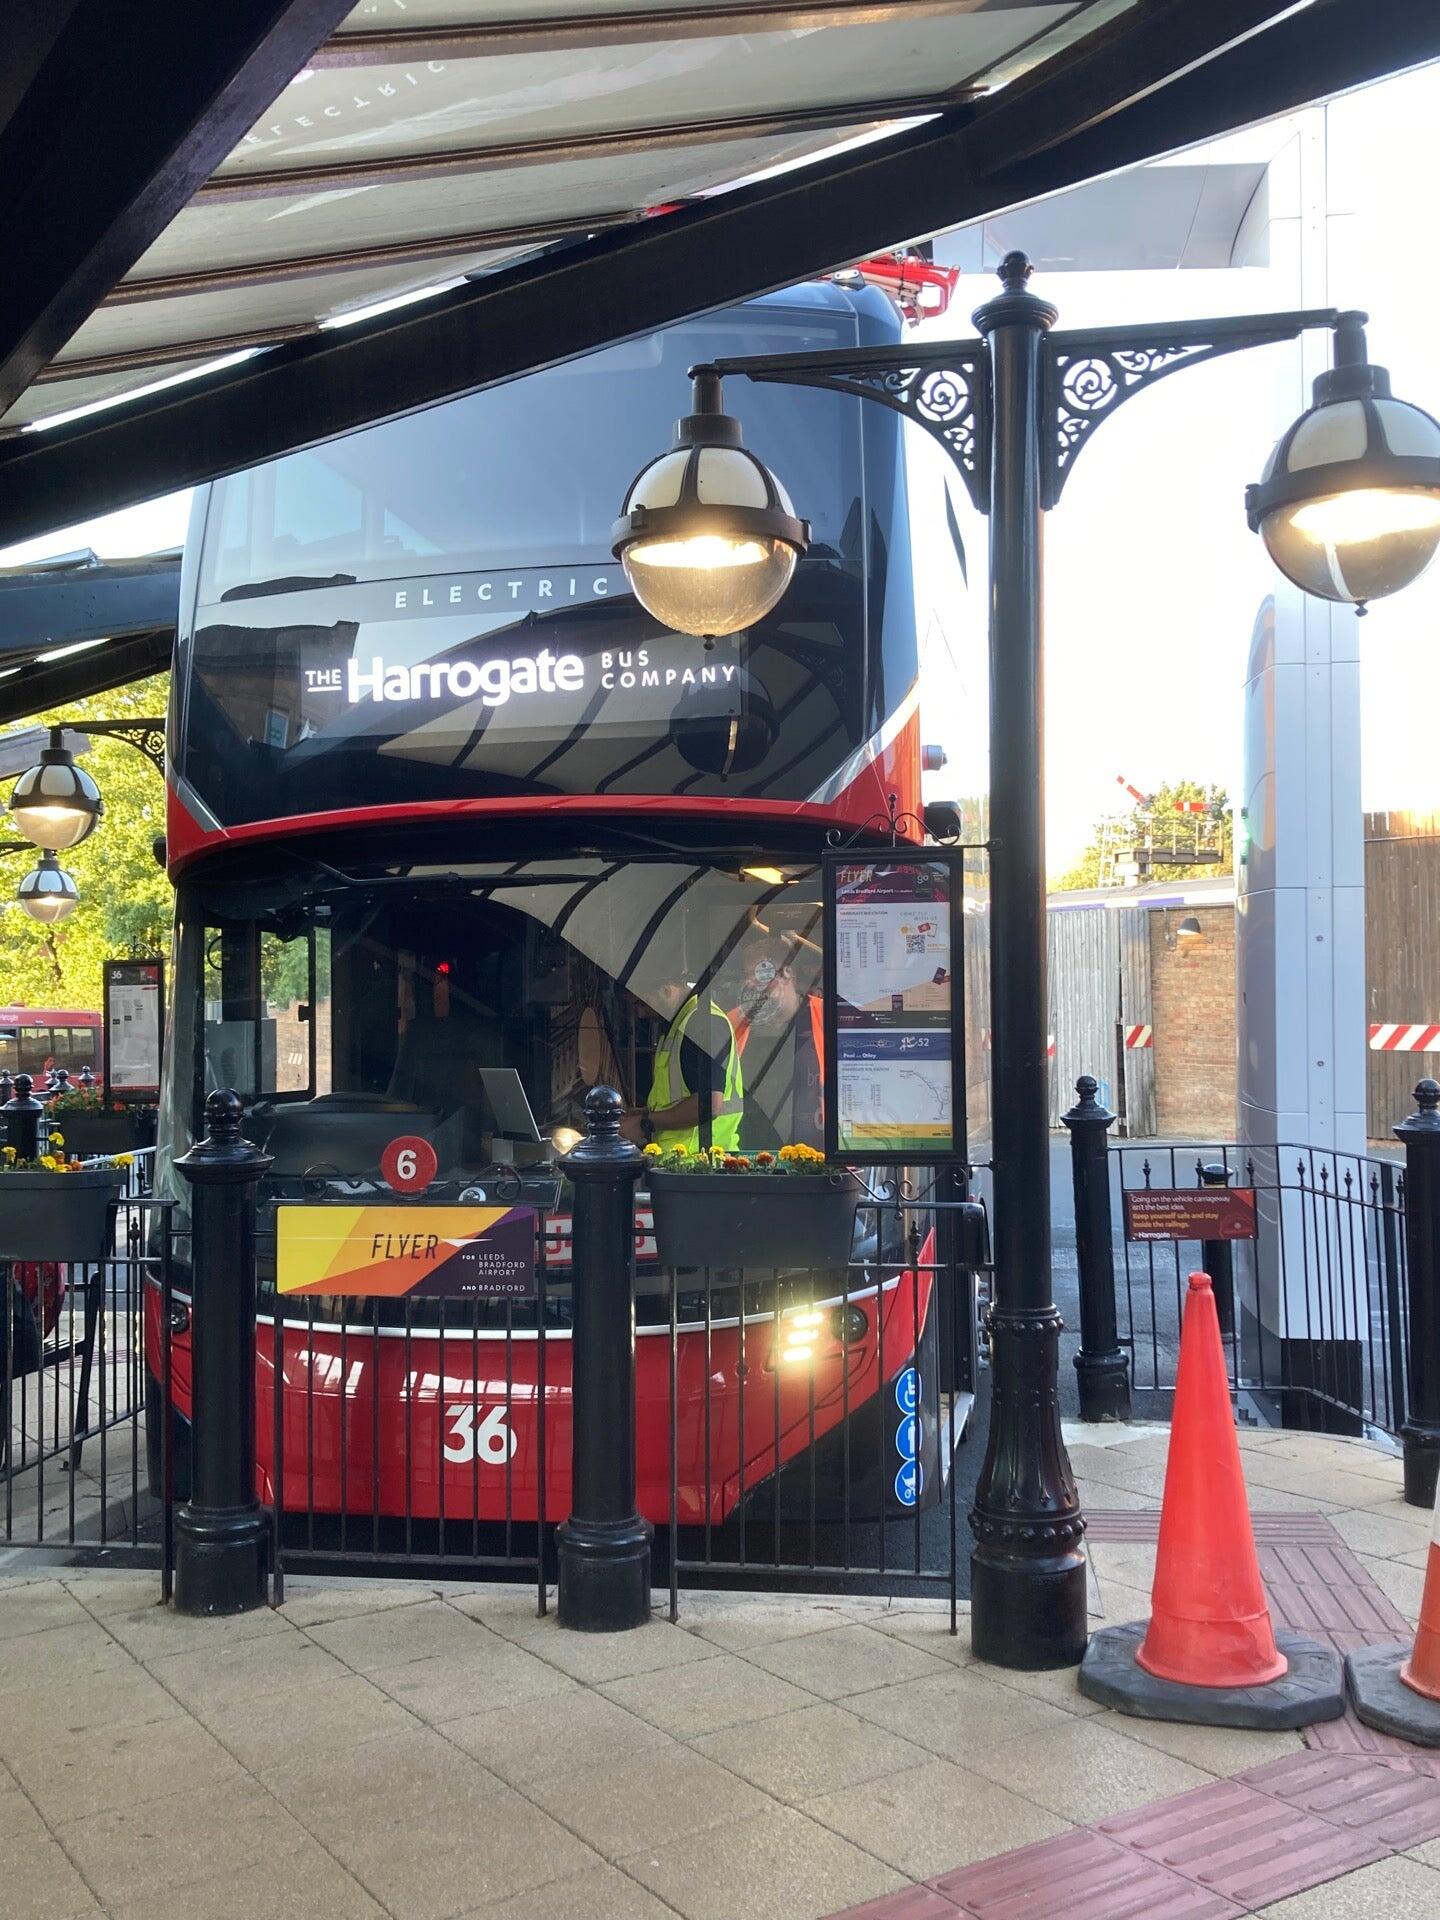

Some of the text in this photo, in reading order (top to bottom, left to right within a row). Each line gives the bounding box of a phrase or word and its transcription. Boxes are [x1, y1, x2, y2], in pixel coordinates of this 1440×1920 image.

[395, 577, 607, 609] ELECTRIC
[601, 650, 648, 669] BUS
[305, 648, 585, 706] THE Harrogate
[601, 665, 735, 690] COMPANY
[840, 870, 873, 883] FLYER
[111, 970, 122, 980] 36
[396, 1149, 417, 1180] 6
[1205, 1212, 1219, 1220] stay
[371, 1233, 439, 1260] FLYER
[478, 1253, 505, 1261] LEEDS
[478, 1261, 526, 1269] BRADFORD
[478, 1284, 526, 1292] BRADFORD
[443, 1404, 518, 1465] 36
